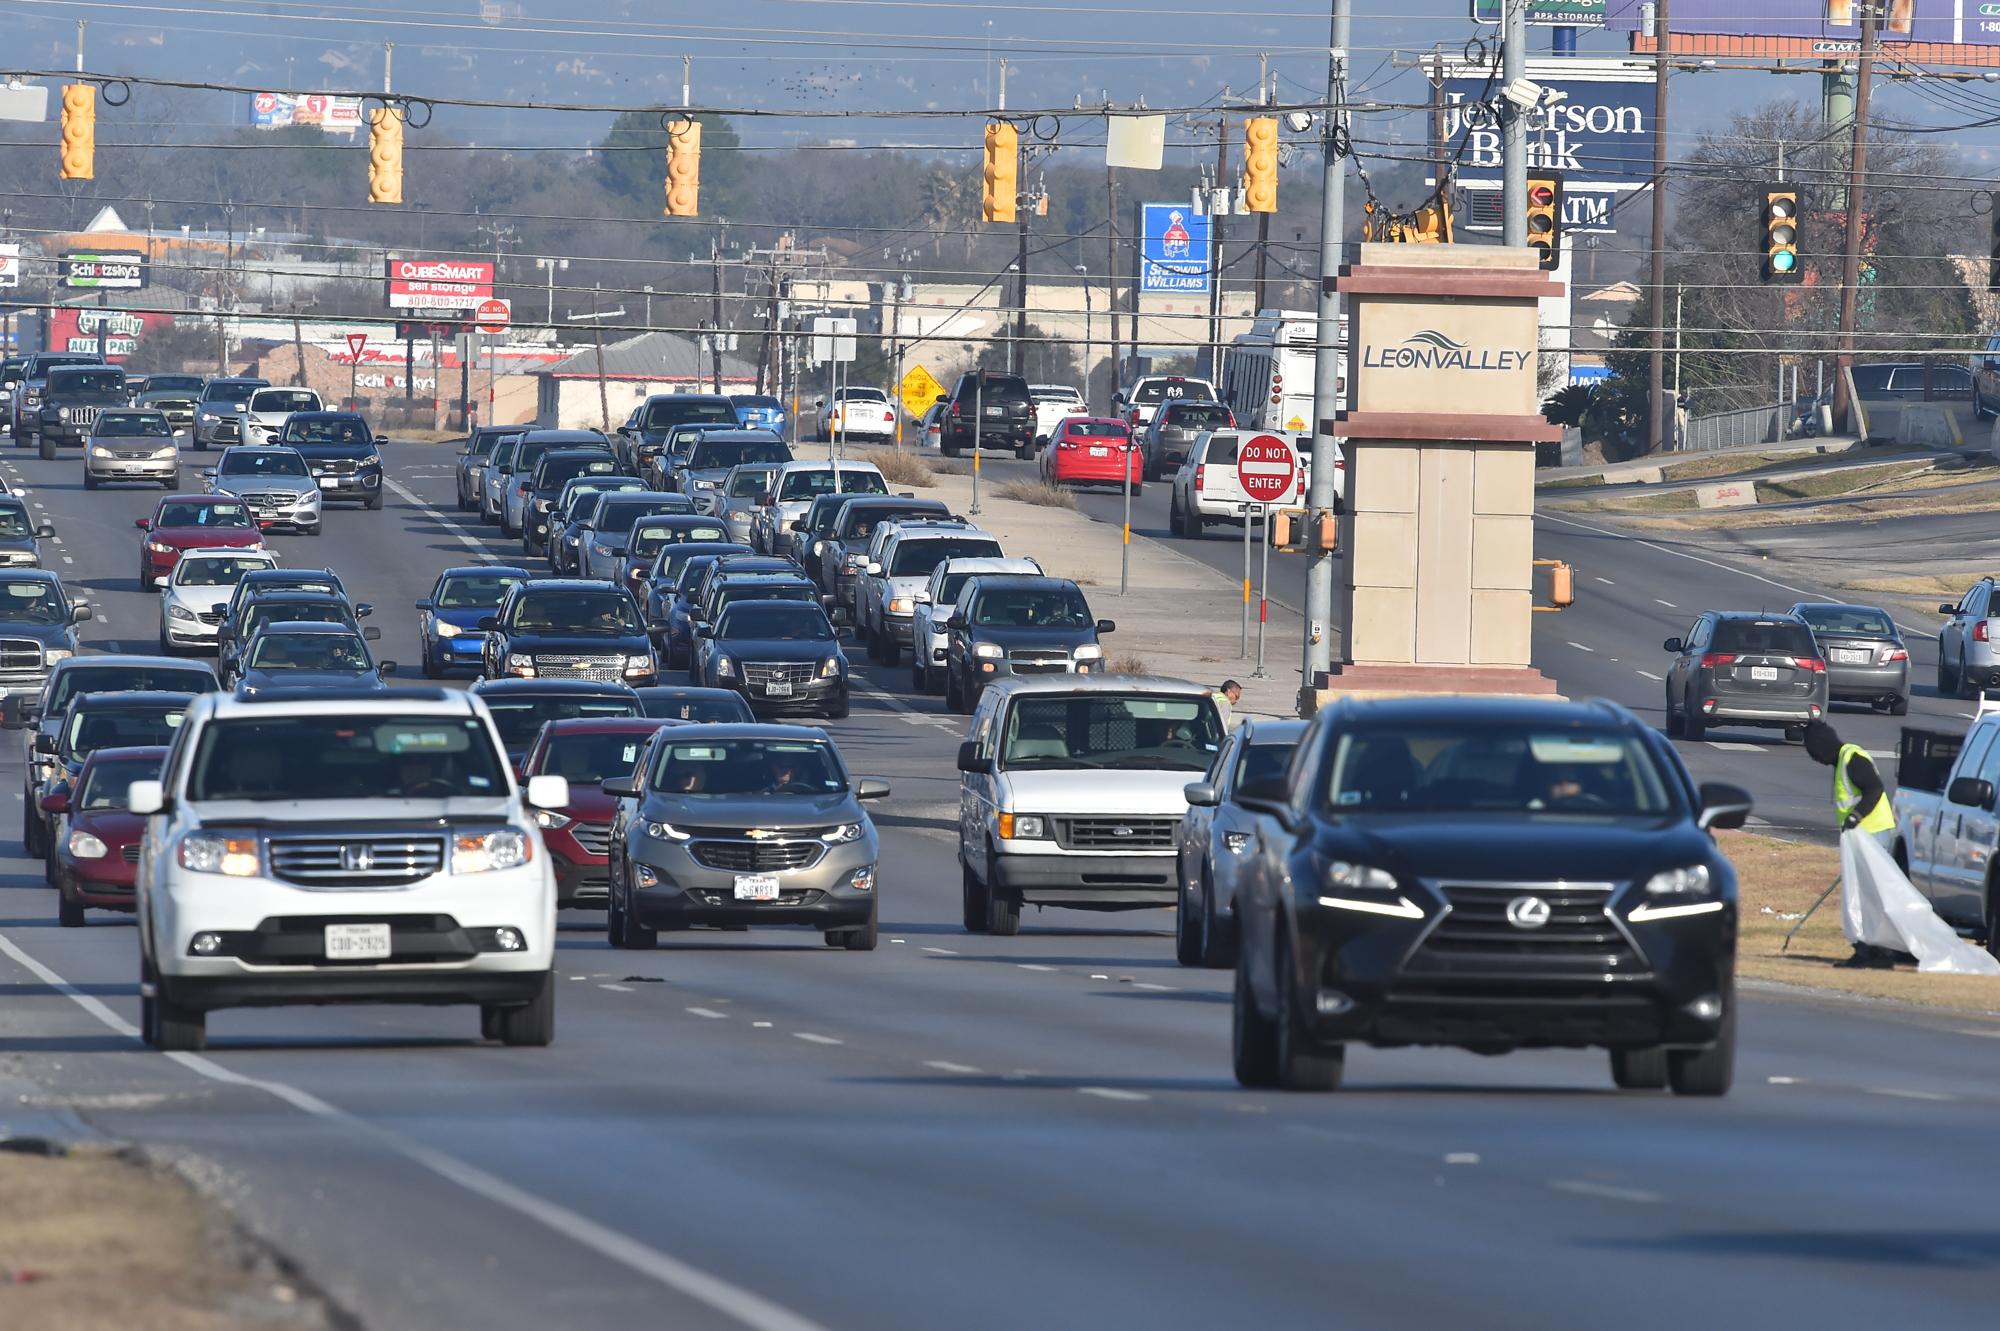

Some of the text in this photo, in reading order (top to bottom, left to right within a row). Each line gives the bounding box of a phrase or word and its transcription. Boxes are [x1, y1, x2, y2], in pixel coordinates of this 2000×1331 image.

[1470, 131, 1584, 169] Bnk
[1246, 447, 1287, 459] DO NOT
[1249, 478, 1281, 489] ENTER
